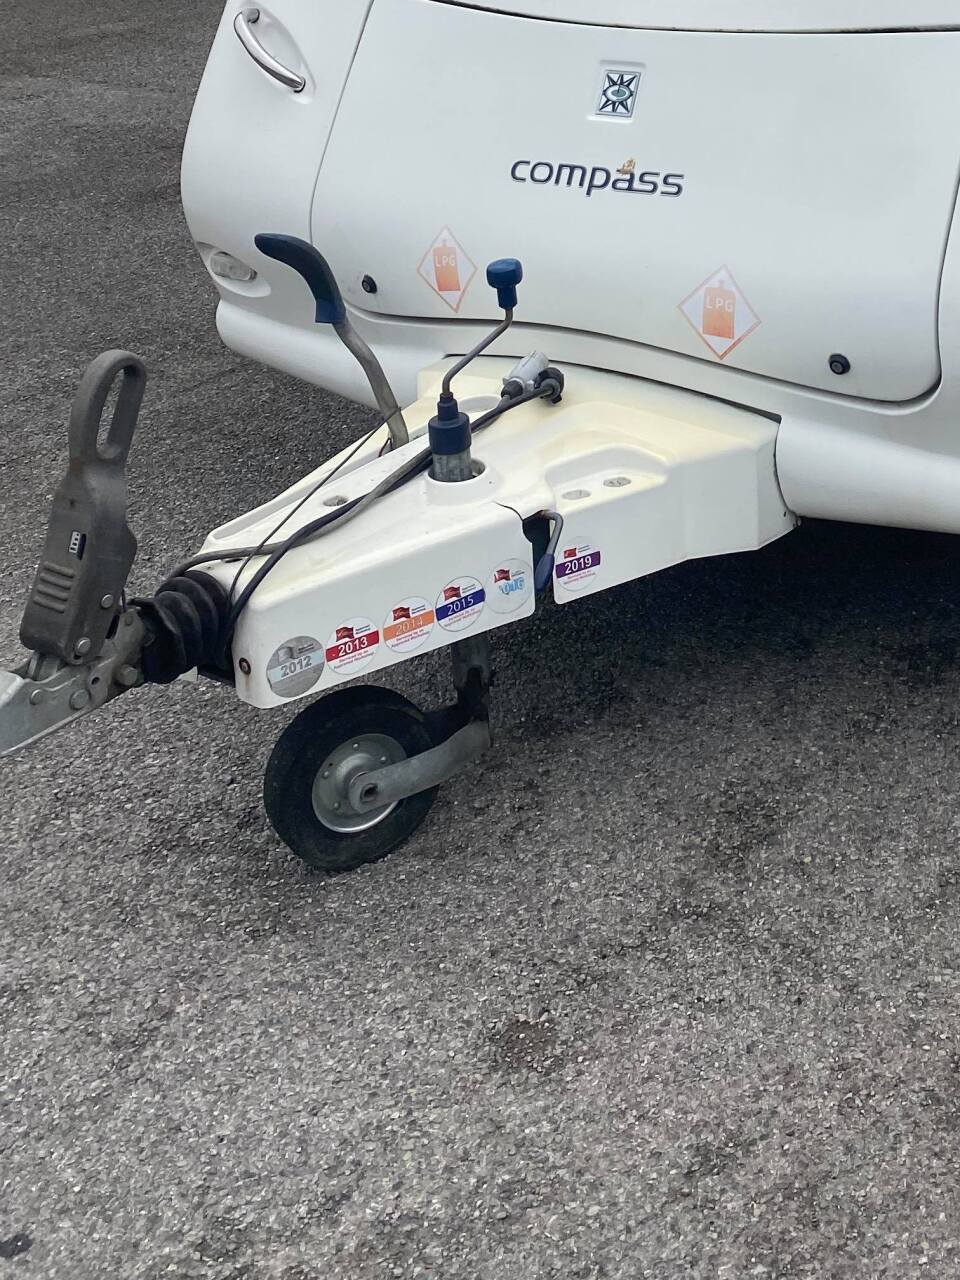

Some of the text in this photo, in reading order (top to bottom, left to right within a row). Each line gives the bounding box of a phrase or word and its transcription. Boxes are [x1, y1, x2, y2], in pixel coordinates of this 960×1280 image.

[510, 159, 685, 197] compass
[435, 255, 456, 268] LPG
[706, 295, 734, 312] LPG
[564, 556, 592, 574] 2019
[446, 595, 474, 615] 2015
[338, 636, 368, 656] 2013
[280, 655, 312, 678] 2012
